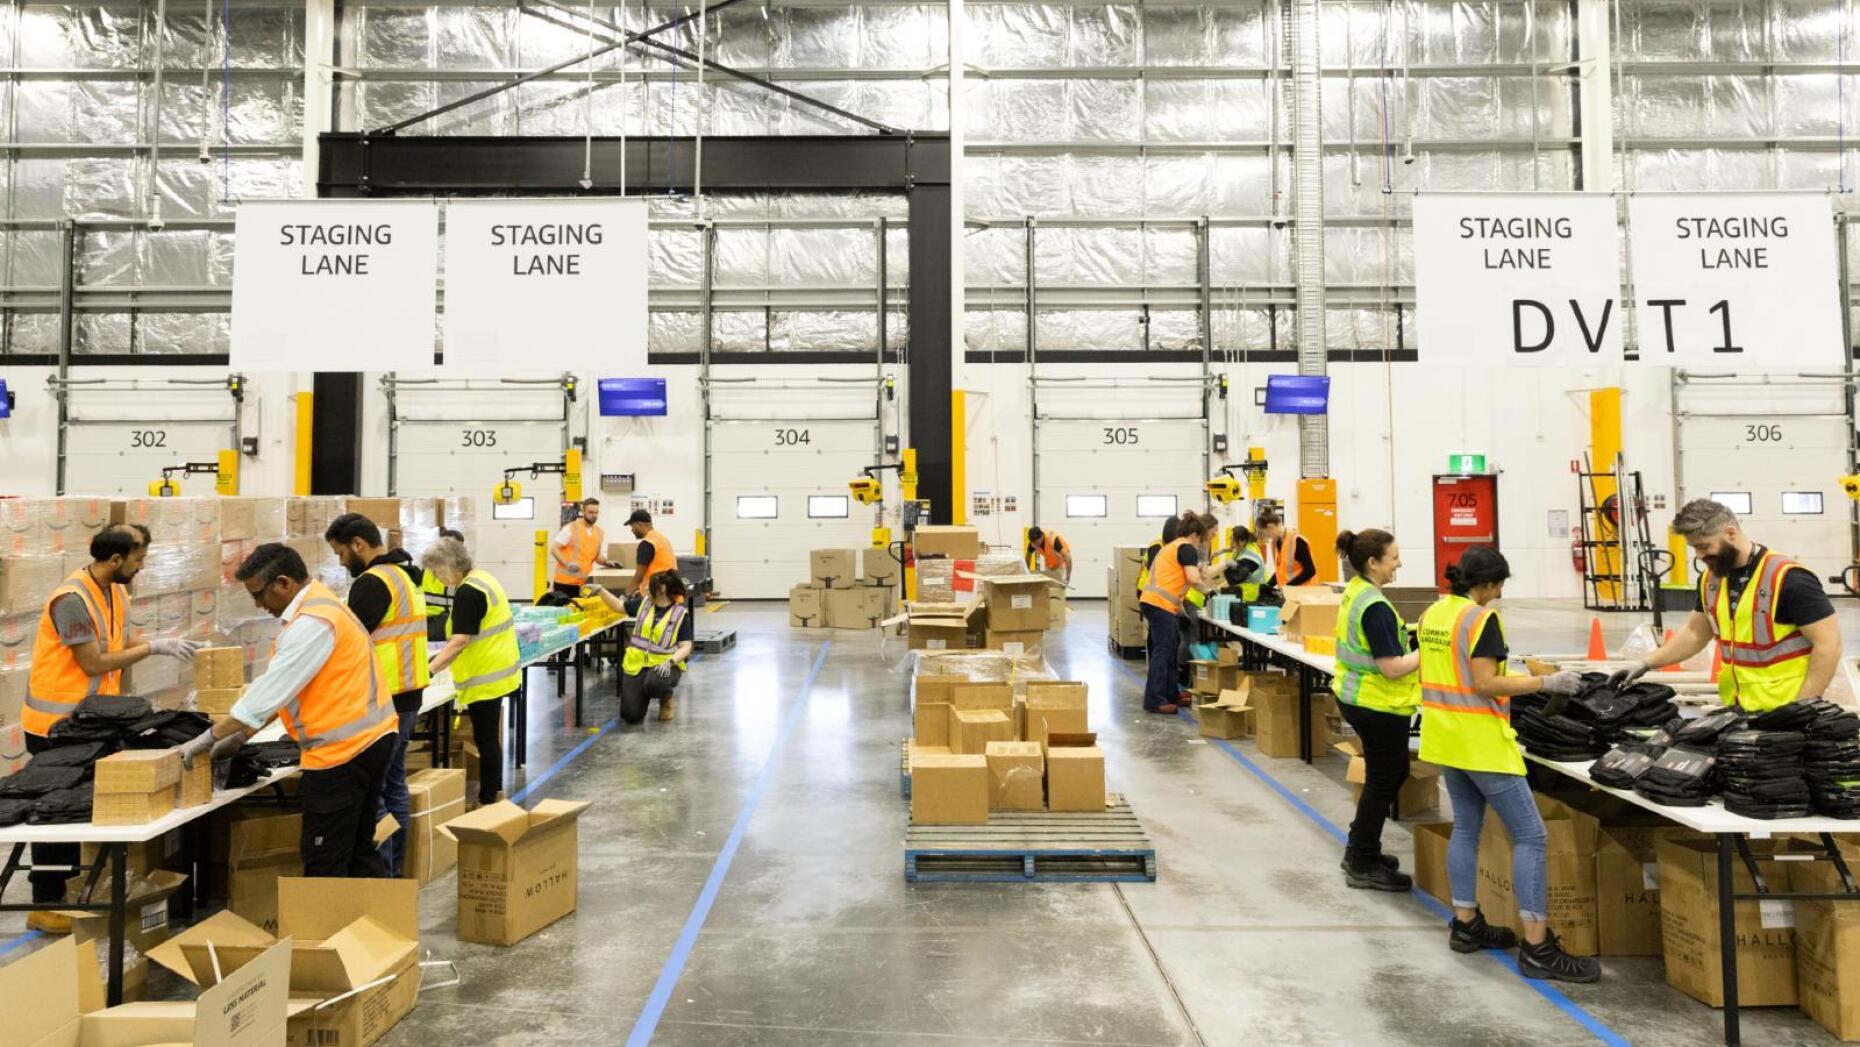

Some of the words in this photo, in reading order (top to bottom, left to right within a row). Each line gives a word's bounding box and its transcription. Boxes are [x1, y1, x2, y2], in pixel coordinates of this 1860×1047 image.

[280, 224, 392, 246] STAGING
[491, 223, 603, 246] STAGING
[1459, 217, 1572, 239] STAGING
[1676, 216, 1788, 239] STAGING
[301, 254, 369, 275] LANE
[513, 254, 580, 276] LANE
[1484, 248, 1551, 269] LANE
[1701, 247, 1769, 269] LANE
[131, 430, 167, 447] 302
[461, 430, 497, 447] 303
[775, 429, 811, 446] 304
[1103, 427, 1139, 445] 305
[1746, 424, 1782, 442] 306
[1447, 493, 1477, 507] 7.05
[525, 869, 568, 899] HALLOW
[223, 998, 238, 1014] LESS
[238, 979, 266, 1002] MATERIAL
